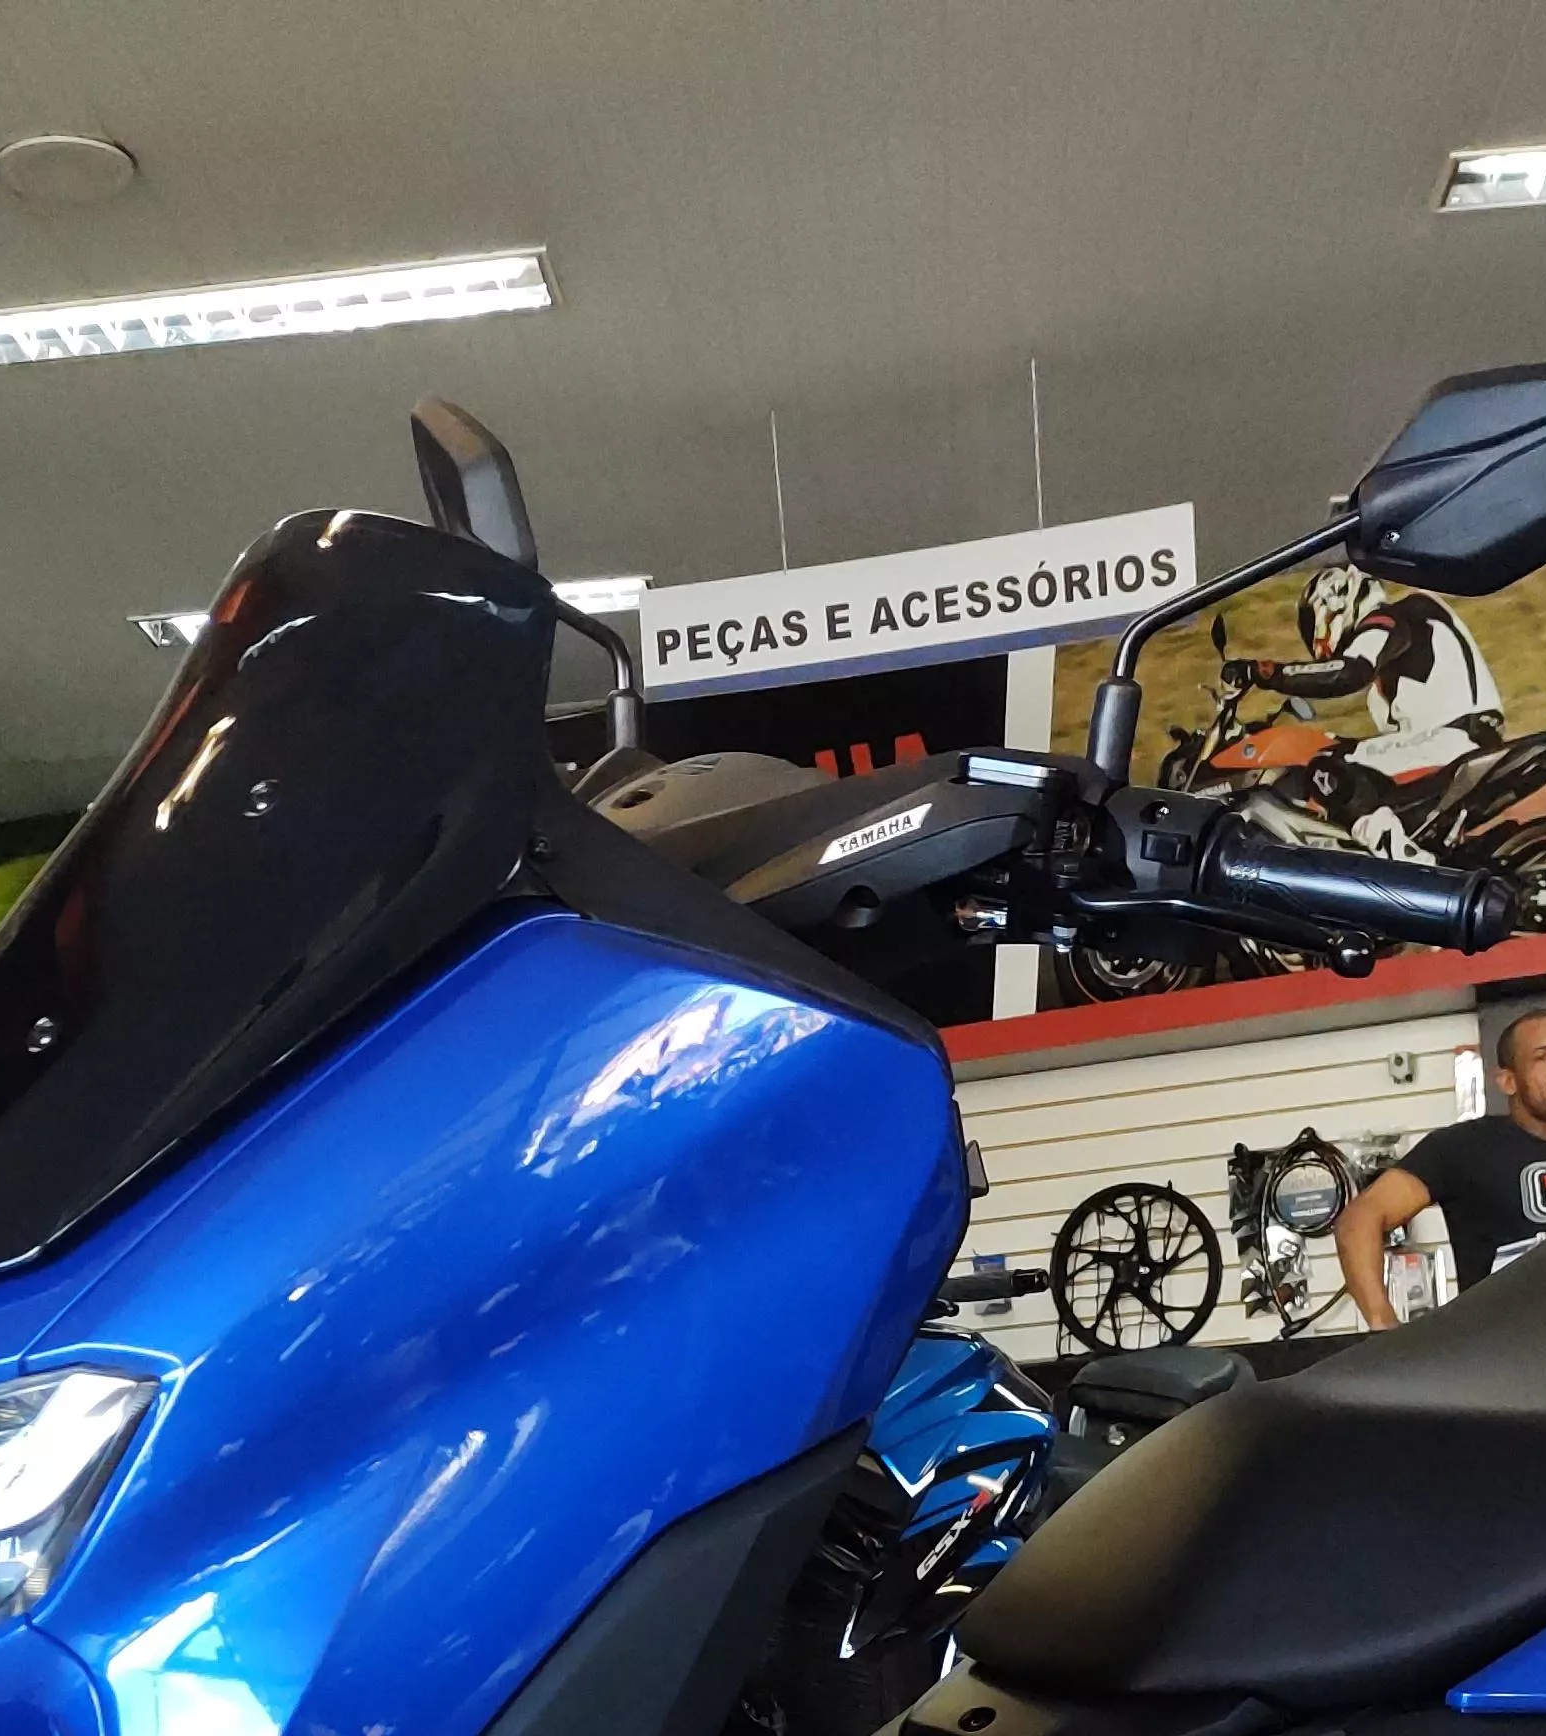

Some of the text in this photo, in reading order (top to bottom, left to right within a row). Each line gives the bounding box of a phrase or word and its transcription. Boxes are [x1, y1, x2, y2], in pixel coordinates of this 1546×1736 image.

[656, 547, 1177, 668] PEÇAS E ACESSÓRIOS
[838, 814, 913, 853] YAMAHA
